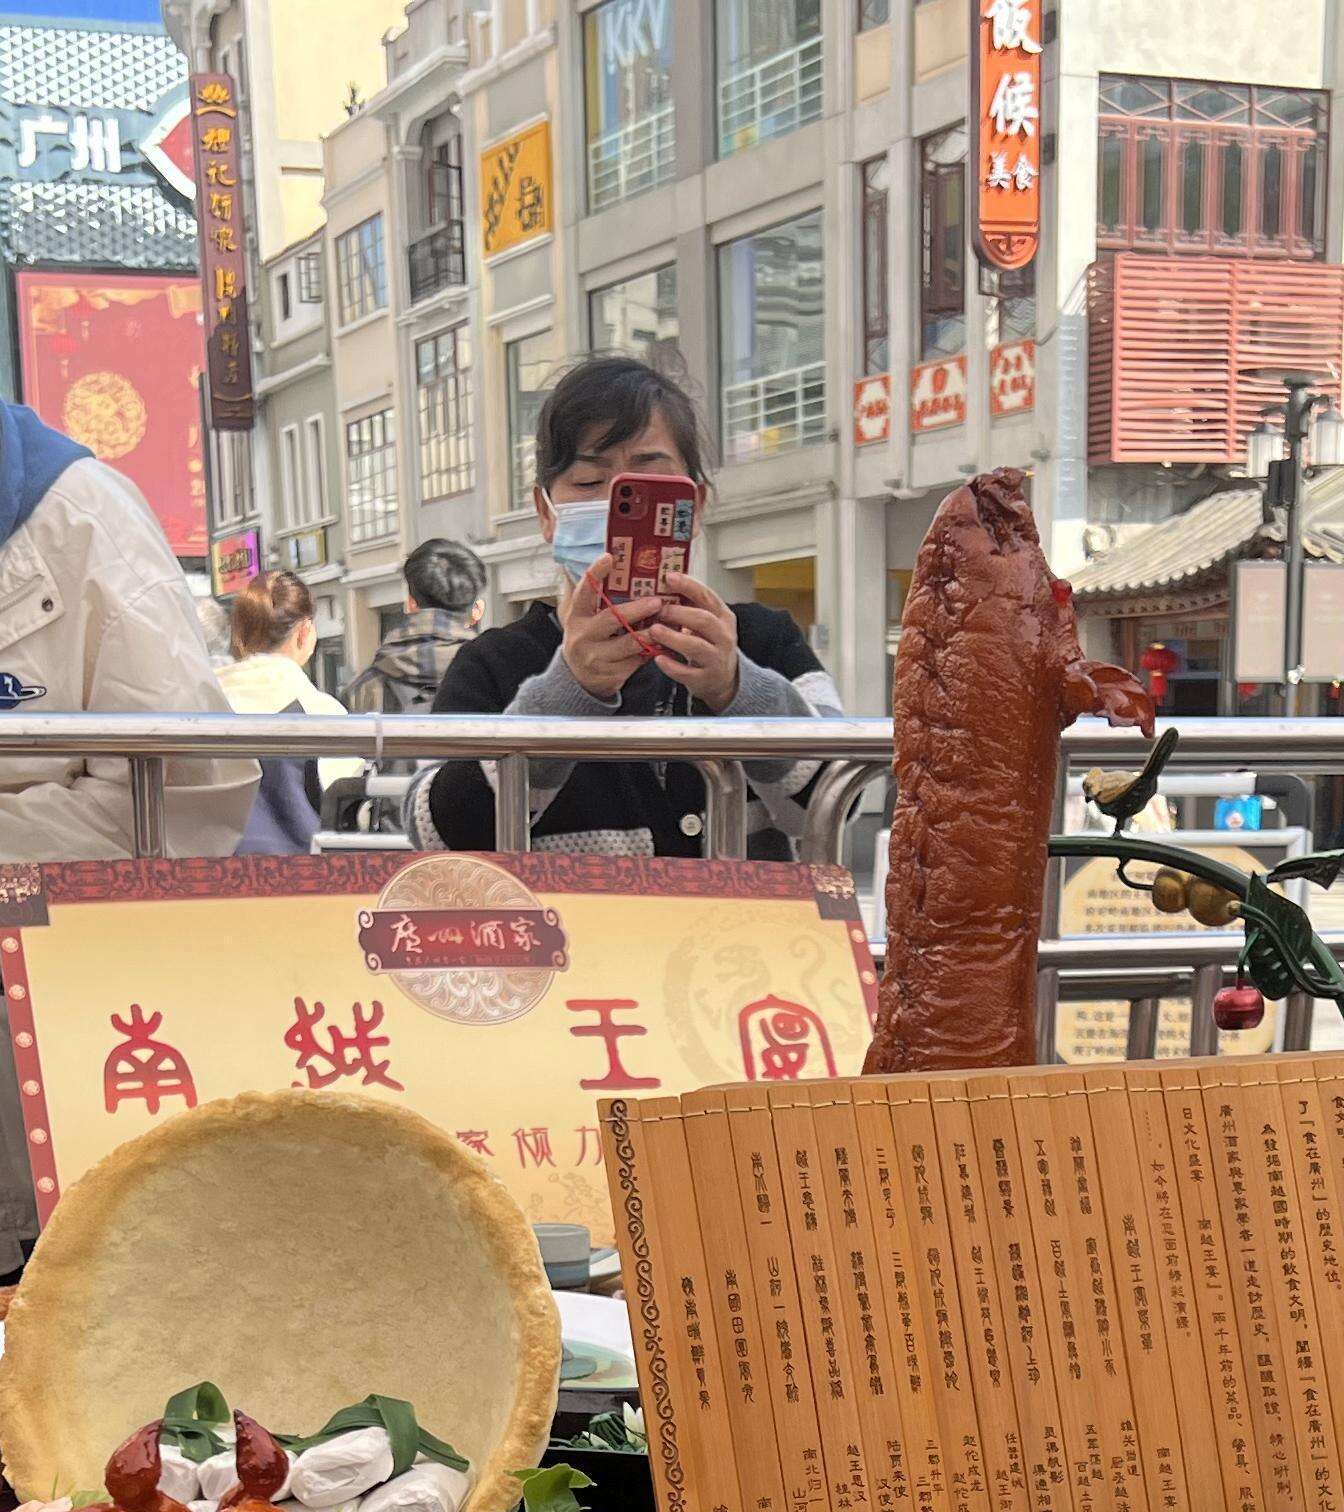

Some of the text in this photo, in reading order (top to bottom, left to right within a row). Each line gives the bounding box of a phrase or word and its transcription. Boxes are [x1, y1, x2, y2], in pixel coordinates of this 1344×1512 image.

[17, 113, 122, 174] 广州
[986, 150, 1040, 192] 美食
[886, 1439, 909, 1499] 陆贾来使
